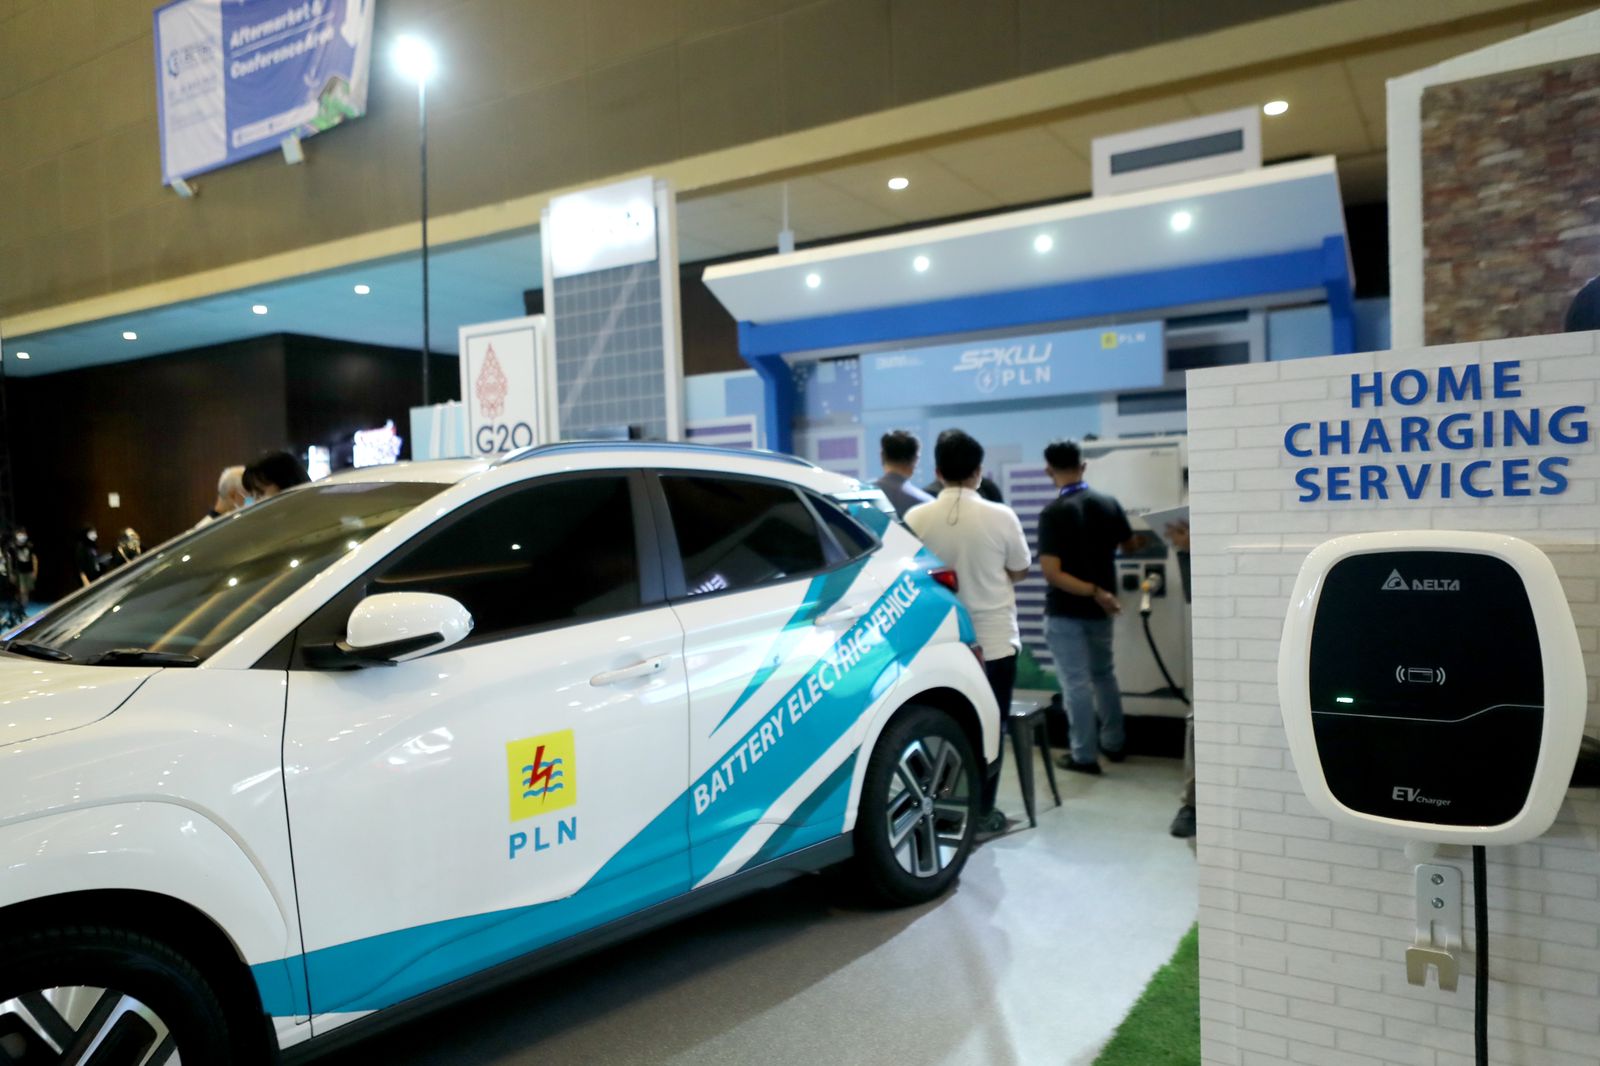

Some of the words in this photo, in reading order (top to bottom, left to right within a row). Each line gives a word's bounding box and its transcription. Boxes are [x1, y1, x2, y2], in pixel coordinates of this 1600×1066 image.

[1002, 366, 1051, 387] PLN
[1350, 360, 1522, 408] HOME
[476, 422, 533, 454] G20
[1283, 405, 1590, 458] CHARGING
[1294, 456, 1570, 503] SERVICES
[1411, 579, 1461, 591] DELTA
[692, 708, 785, 816] BATTERY
[786, 627, 872, 726] ELECTRIC
[864, 574, 921, 636] VEHICLE
[1392, 786, 1421, 802] EV
[1415, 795, 1452, 807] Charger
[508, 816, 578, 860] PLN
